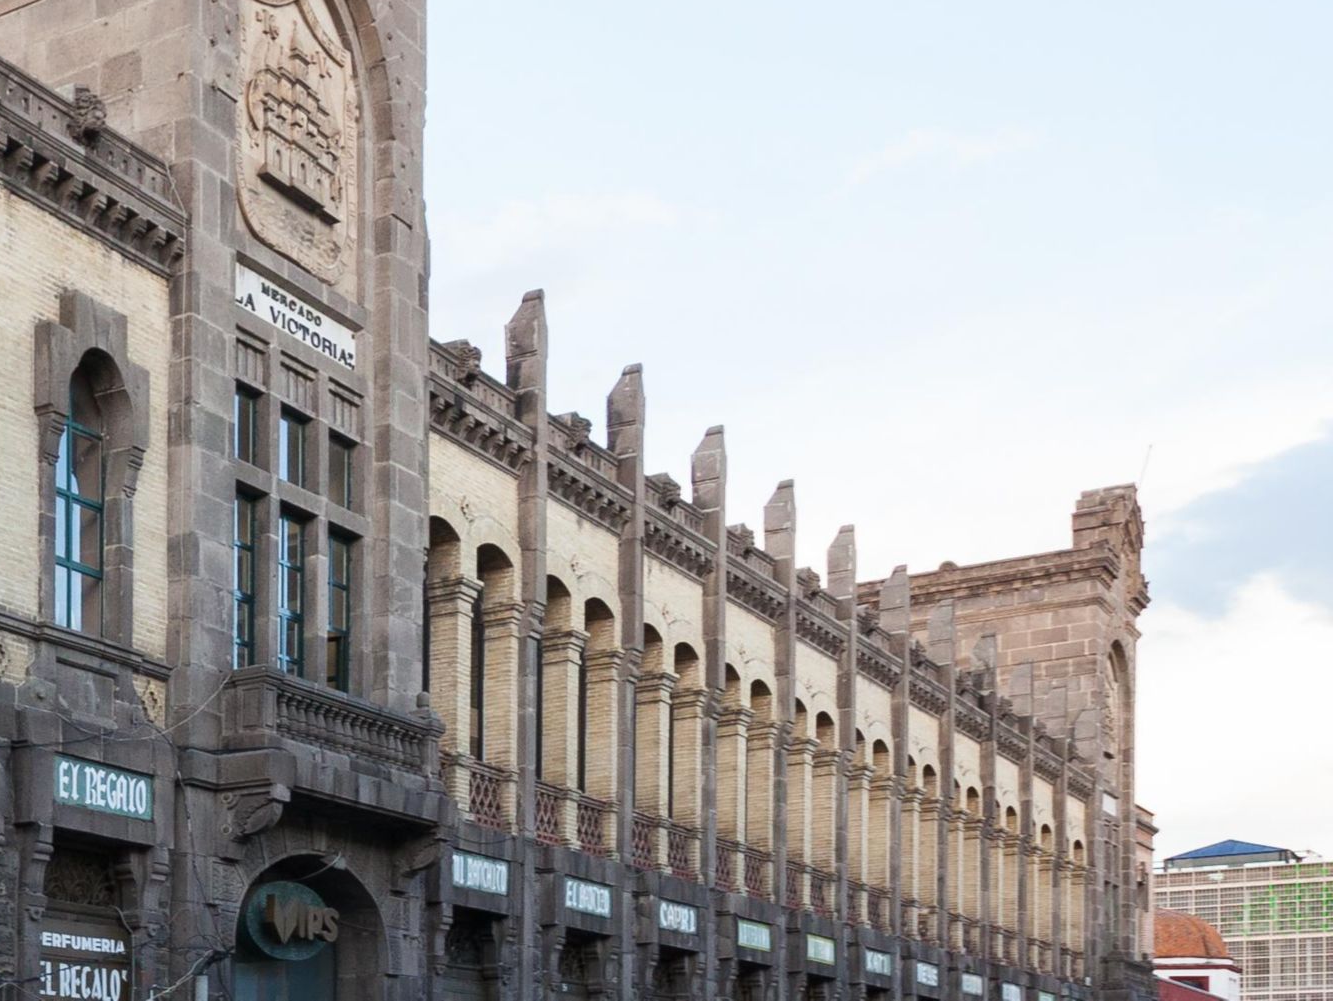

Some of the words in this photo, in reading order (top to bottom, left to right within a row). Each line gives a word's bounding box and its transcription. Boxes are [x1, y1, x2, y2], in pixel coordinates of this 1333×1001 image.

[261, 282, 322, 327] MERCADO
[84, 766, 146, 814] REGALO
[659, 902, 695, 933] CAPRI
[41, 931, 125, 954] ERFUMERIA
